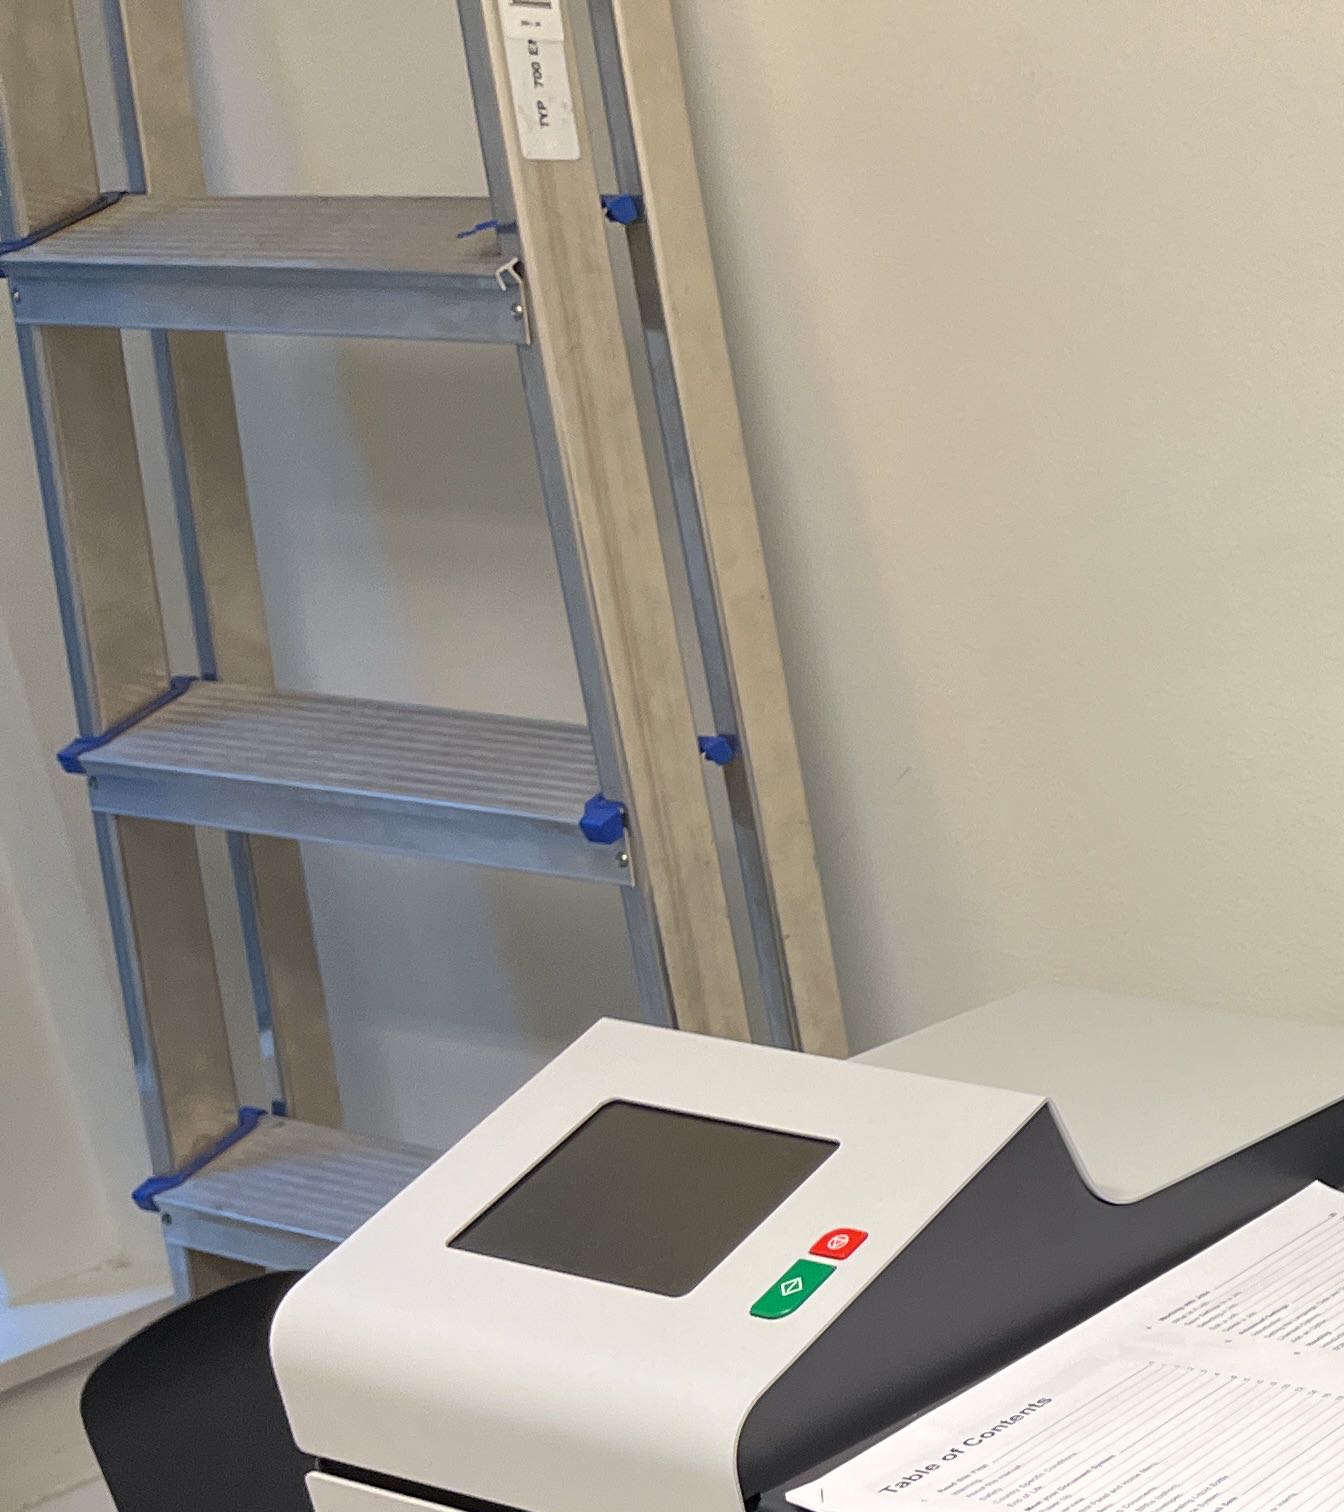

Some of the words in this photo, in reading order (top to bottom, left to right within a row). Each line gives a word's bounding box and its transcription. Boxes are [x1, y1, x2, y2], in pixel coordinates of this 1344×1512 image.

[878, 1463, 941, 1493] Table
[942, 1447, 965, 1462] of
[963, 1397, 1052, 1447] Contents
